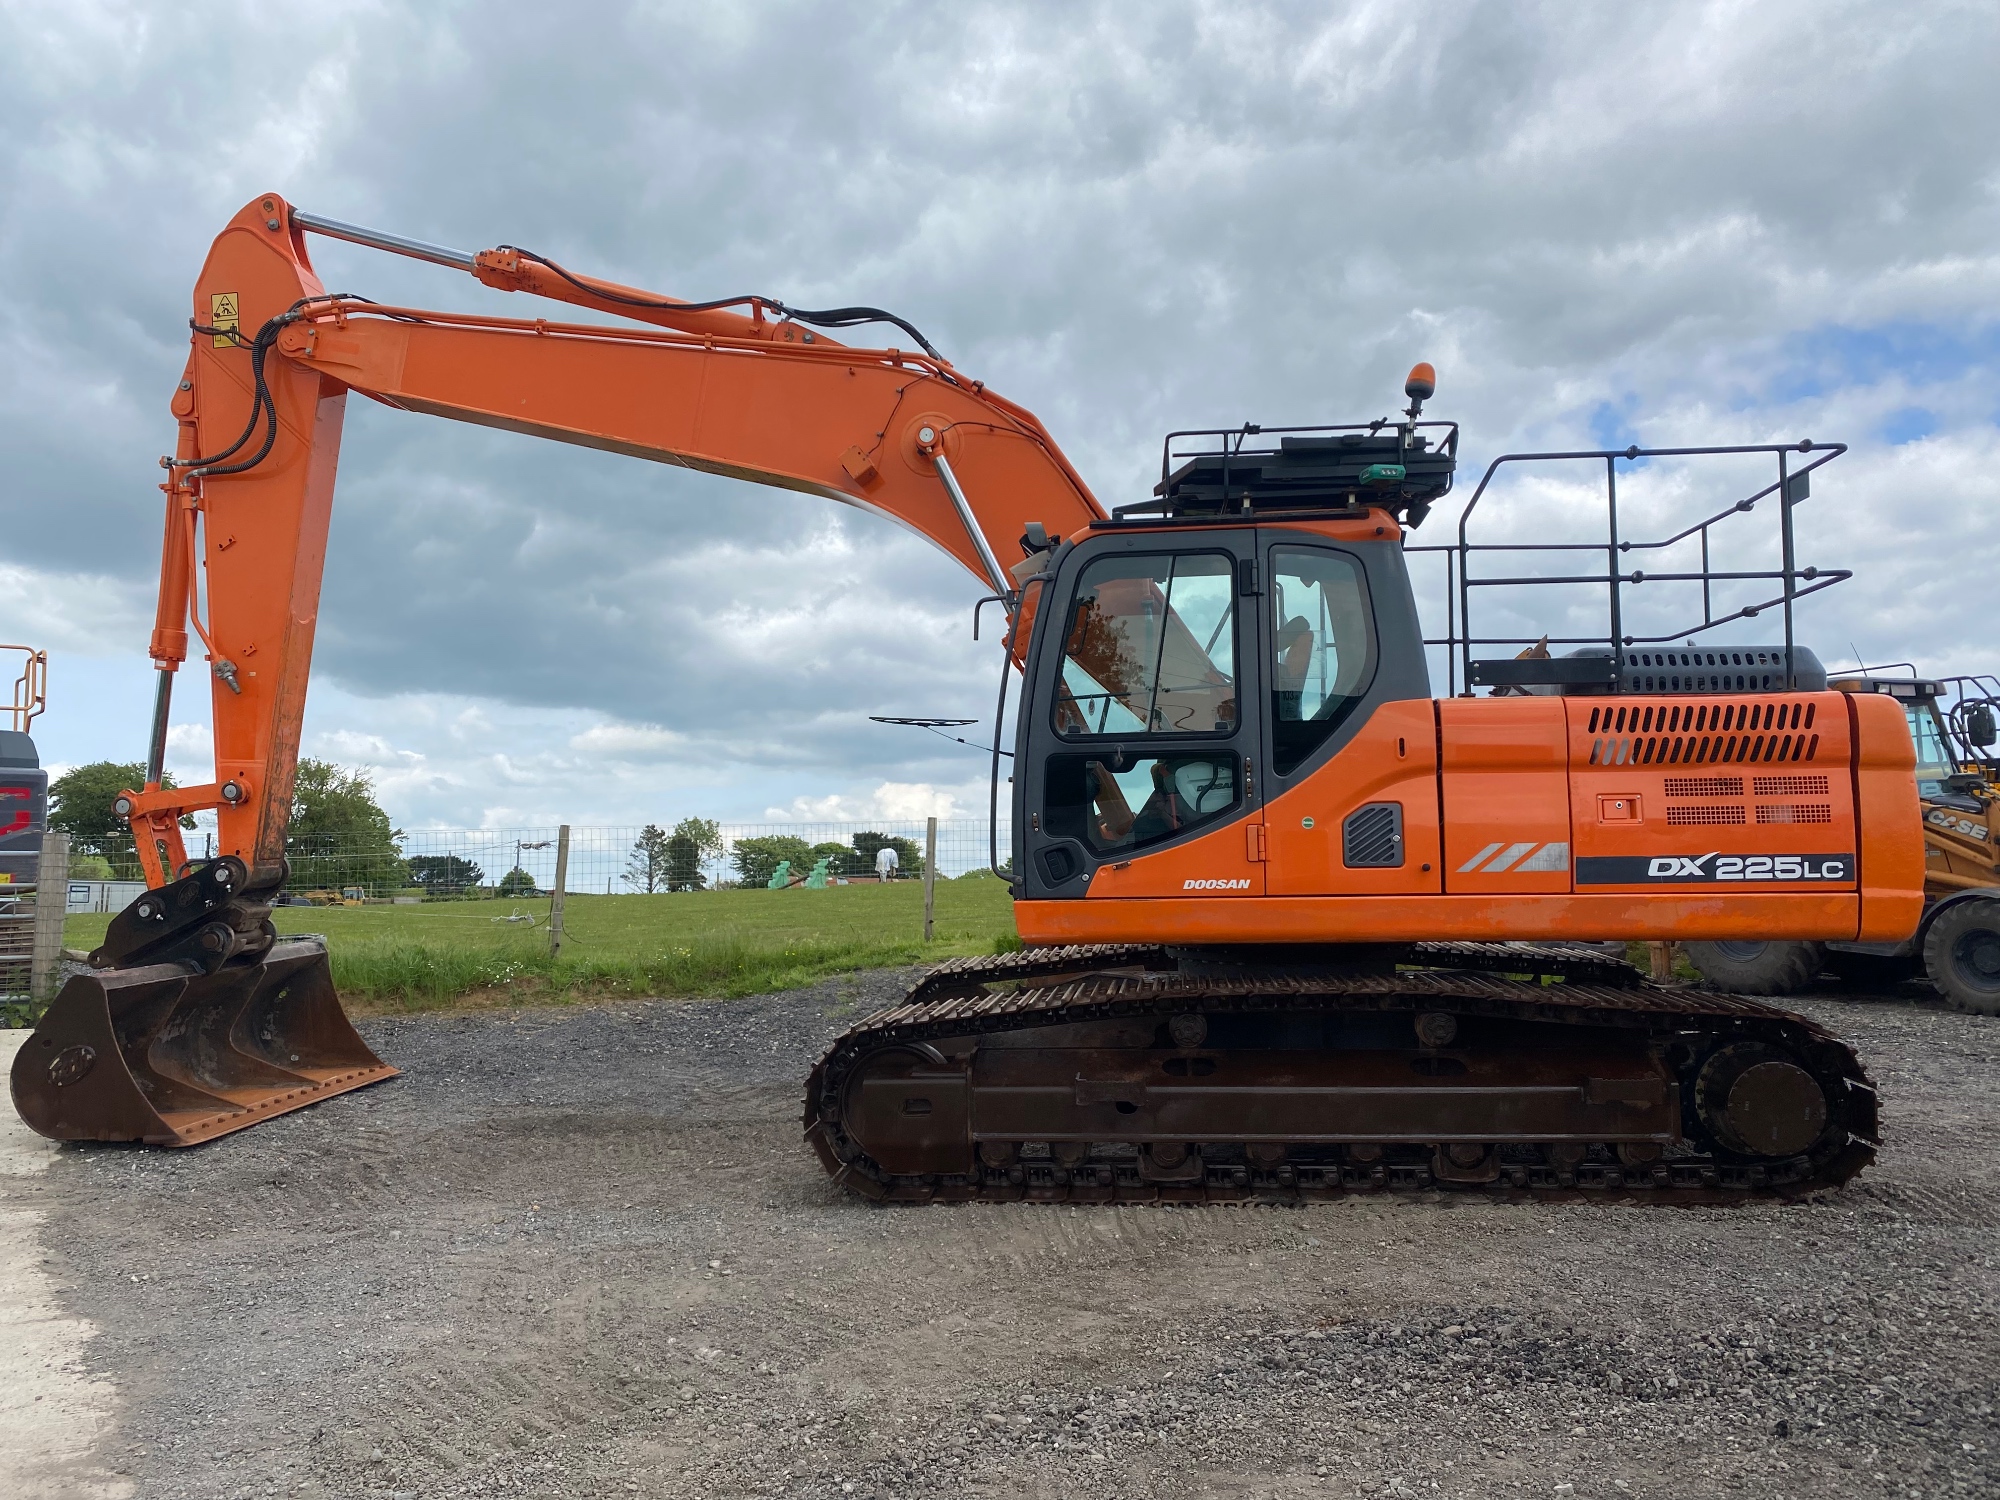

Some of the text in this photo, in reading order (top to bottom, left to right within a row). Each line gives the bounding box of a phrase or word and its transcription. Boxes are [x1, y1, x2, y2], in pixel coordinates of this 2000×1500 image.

[1928, 810, 1989, 839] CASE
[1648, 851, 1721, 876] DX
[1183, 879, 1251, 889] DOOSAN
